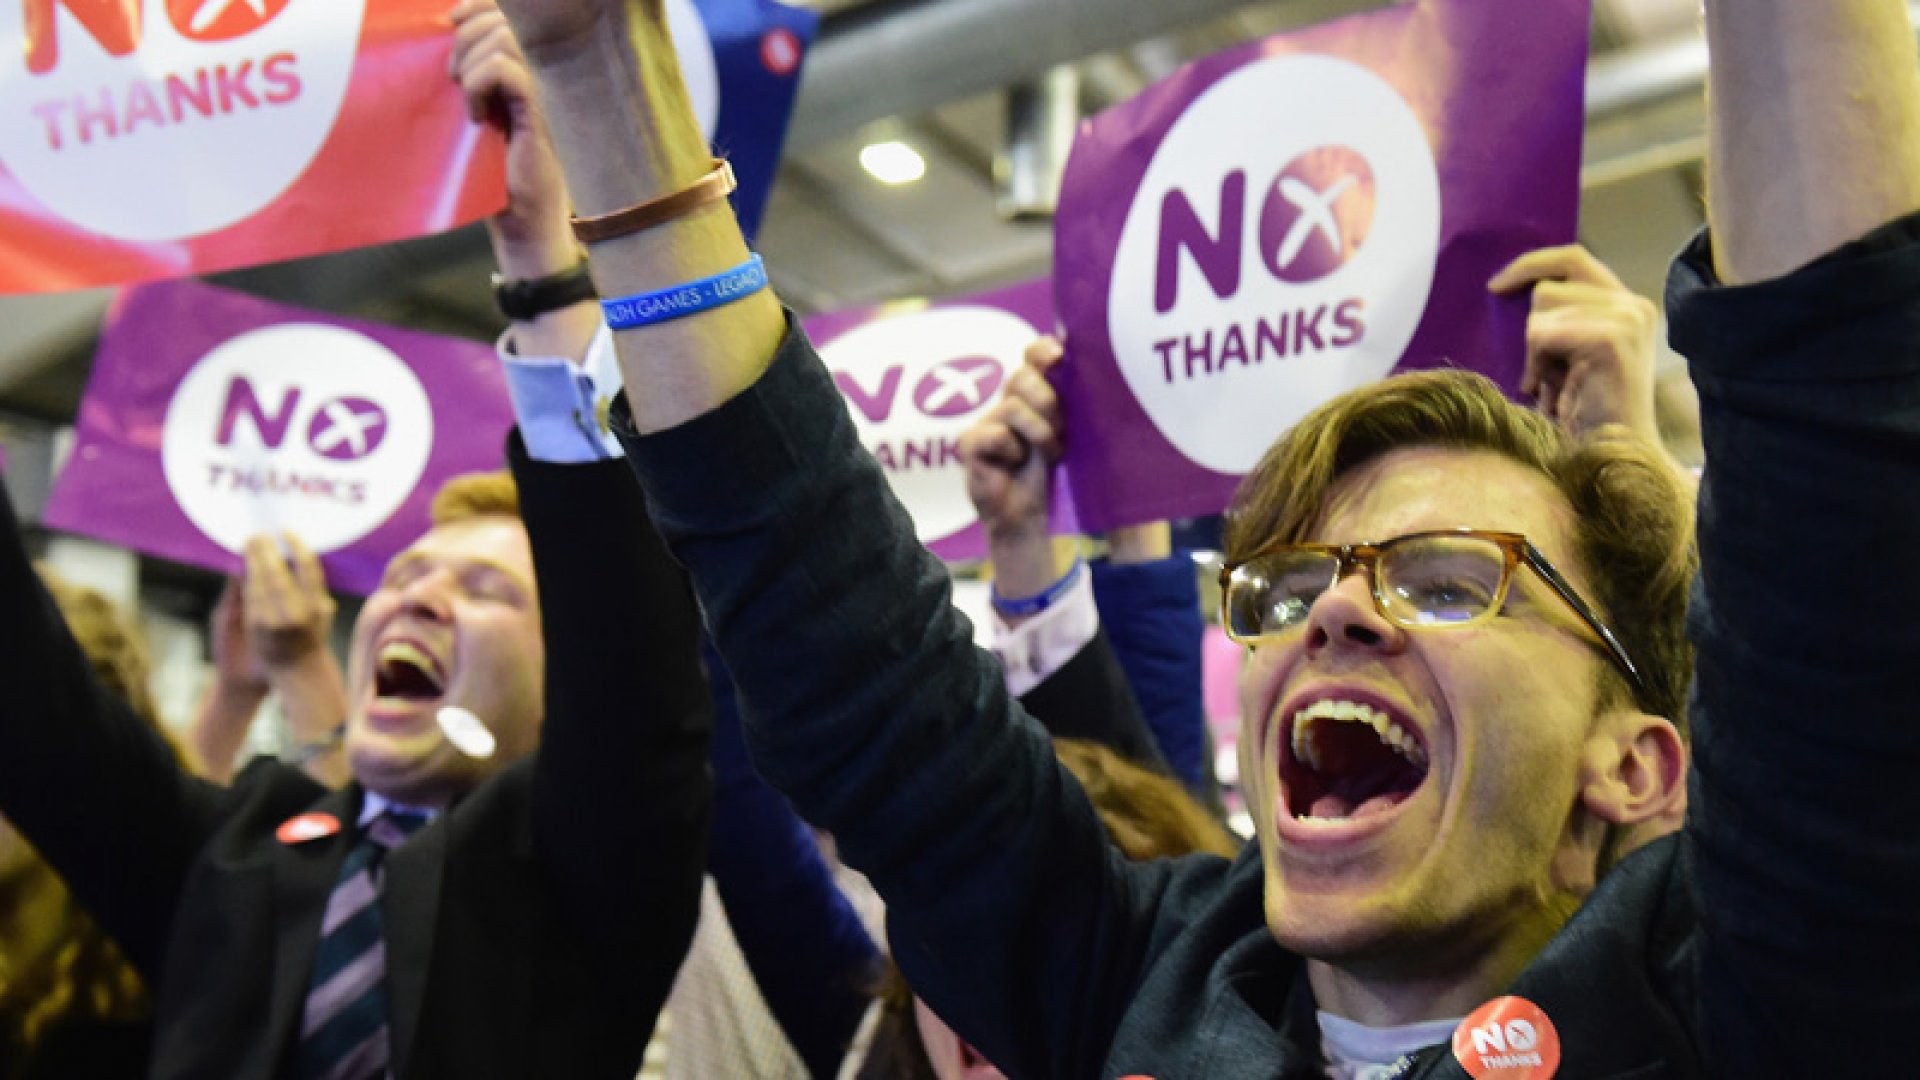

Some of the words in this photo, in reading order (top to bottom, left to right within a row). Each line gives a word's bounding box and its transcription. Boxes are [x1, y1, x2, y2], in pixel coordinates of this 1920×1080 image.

[31, 51, 304, 151] THANKS
[1153, 144, 1376, 315] NO
[637, 288, 701, 318] GAMES
[713, 268, 760, 298] LEGAC
[1152, 298, 1366, 383] THANKS
[215, 373, 389, 461] NO
[876, 437, 965, 470] ANK
[1471, 1018, 1537, 1055] NO
[1479, 1051, 1543, 1070] THANKS
